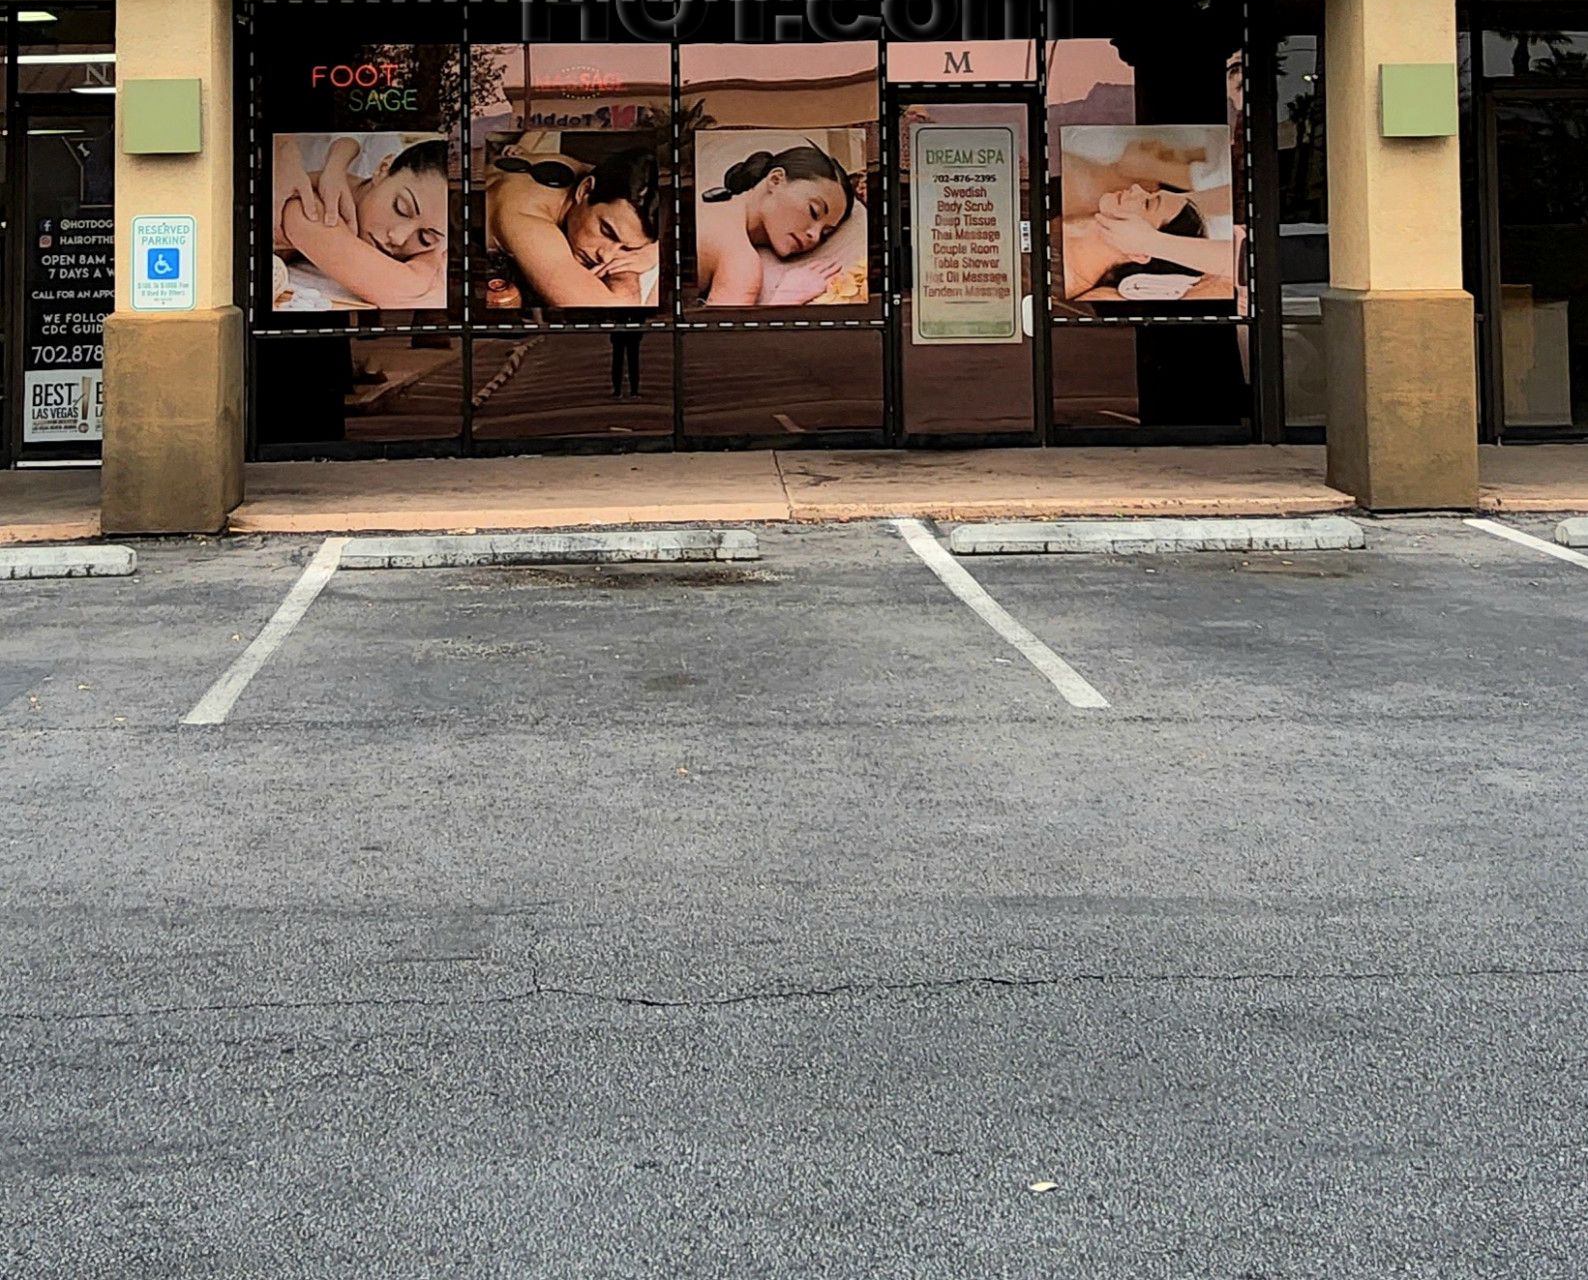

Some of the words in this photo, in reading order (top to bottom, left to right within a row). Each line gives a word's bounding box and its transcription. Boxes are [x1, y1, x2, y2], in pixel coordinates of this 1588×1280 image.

[943, 51, 974, 74] M
[84, 63, 112, 86] N
[312, 64, 399, 89] FOOT
[925, 148, 974, 165] DREAM
[977, 148, 1005, 164] SPA
[932, 174, 997, 183] 702-876-2395
[943, 186, 988, 198] Swedish
[937, 200, 962, 213] Body
[964, 200, 994, 211] Scrub
[60, 219, 114, 231] @HOTDOG
[963, 214, 997, 227] Tissue
[138, 225, 190, 235] RESERVED
[931, 229, 953, 240] Thai
[955, 229, 1001, 242] Massage
[142, 236, 186, 246] PARKING
[933, 243, 967, 256] Couple
[970, 243, 999, 255] Room
[41, 255, 76, 266] OPEN
[79, 255, 107, 265] 8AM
[934, 258, 959, 269] Table
[962, 257, 1000, 269] Shower
[48, 268, 56, 280] 7
[60, 268, 90, 279] DAYS
[93, 268, 102, 278] A
[946, 271, 960, 283] Oil
[962, 271, 1008, 285] Massage
[31, 290, 55, 299] CALL
[56, 290, 75, 299] FOR
[77, 290, 91, 299] AN
[923, 285, 962, 298] Tandem
[43, 314, 60, 323] WE
[65, 313, 109, 323] FOLLO
[41, 325, 67, 335] CDC
[32, 382, 79, 408] BEST
[32, 408, 49, 420] LAS
[50, 407, 79, 419] VEGAS
